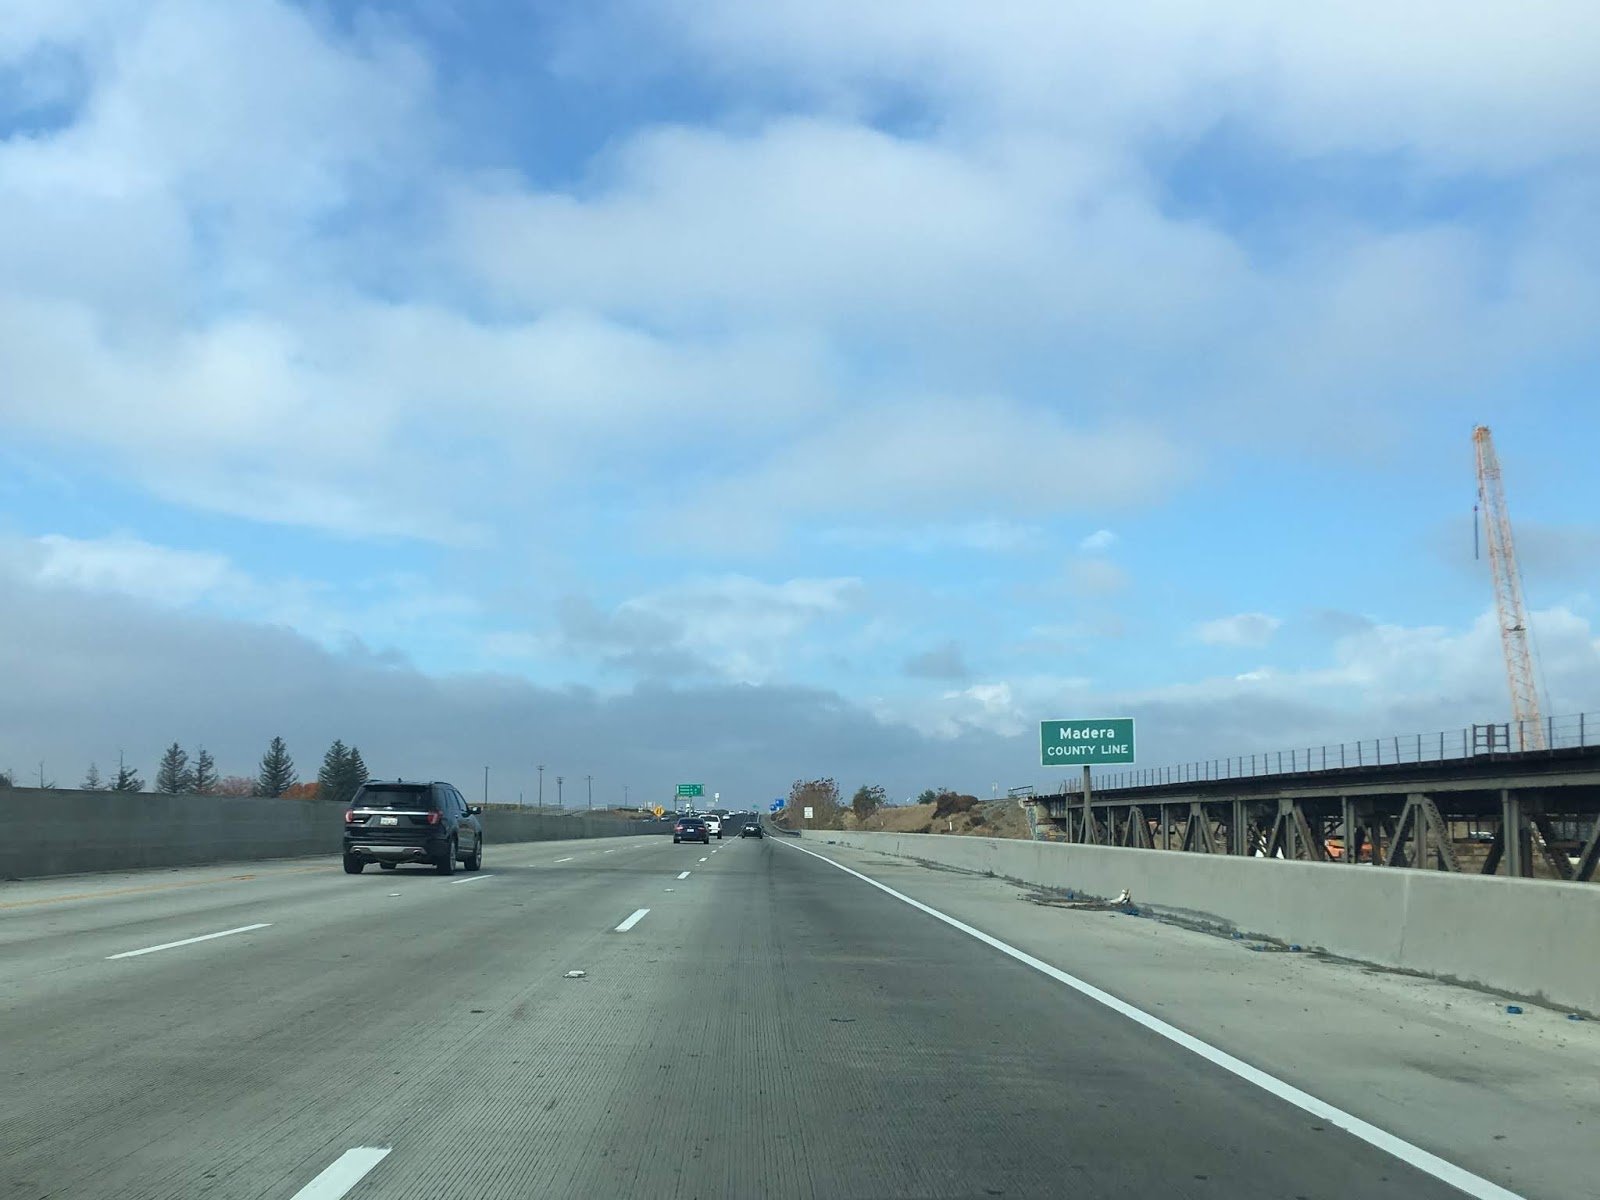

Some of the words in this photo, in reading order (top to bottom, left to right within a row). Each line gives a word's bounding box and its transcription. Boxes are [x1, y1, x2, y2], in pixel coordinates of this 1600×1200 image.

[1060, 727, 1114, 740] Madera
[1047, 745, 1096, 756] COUNTY
[1101, 744, 1129, 754] LINE
